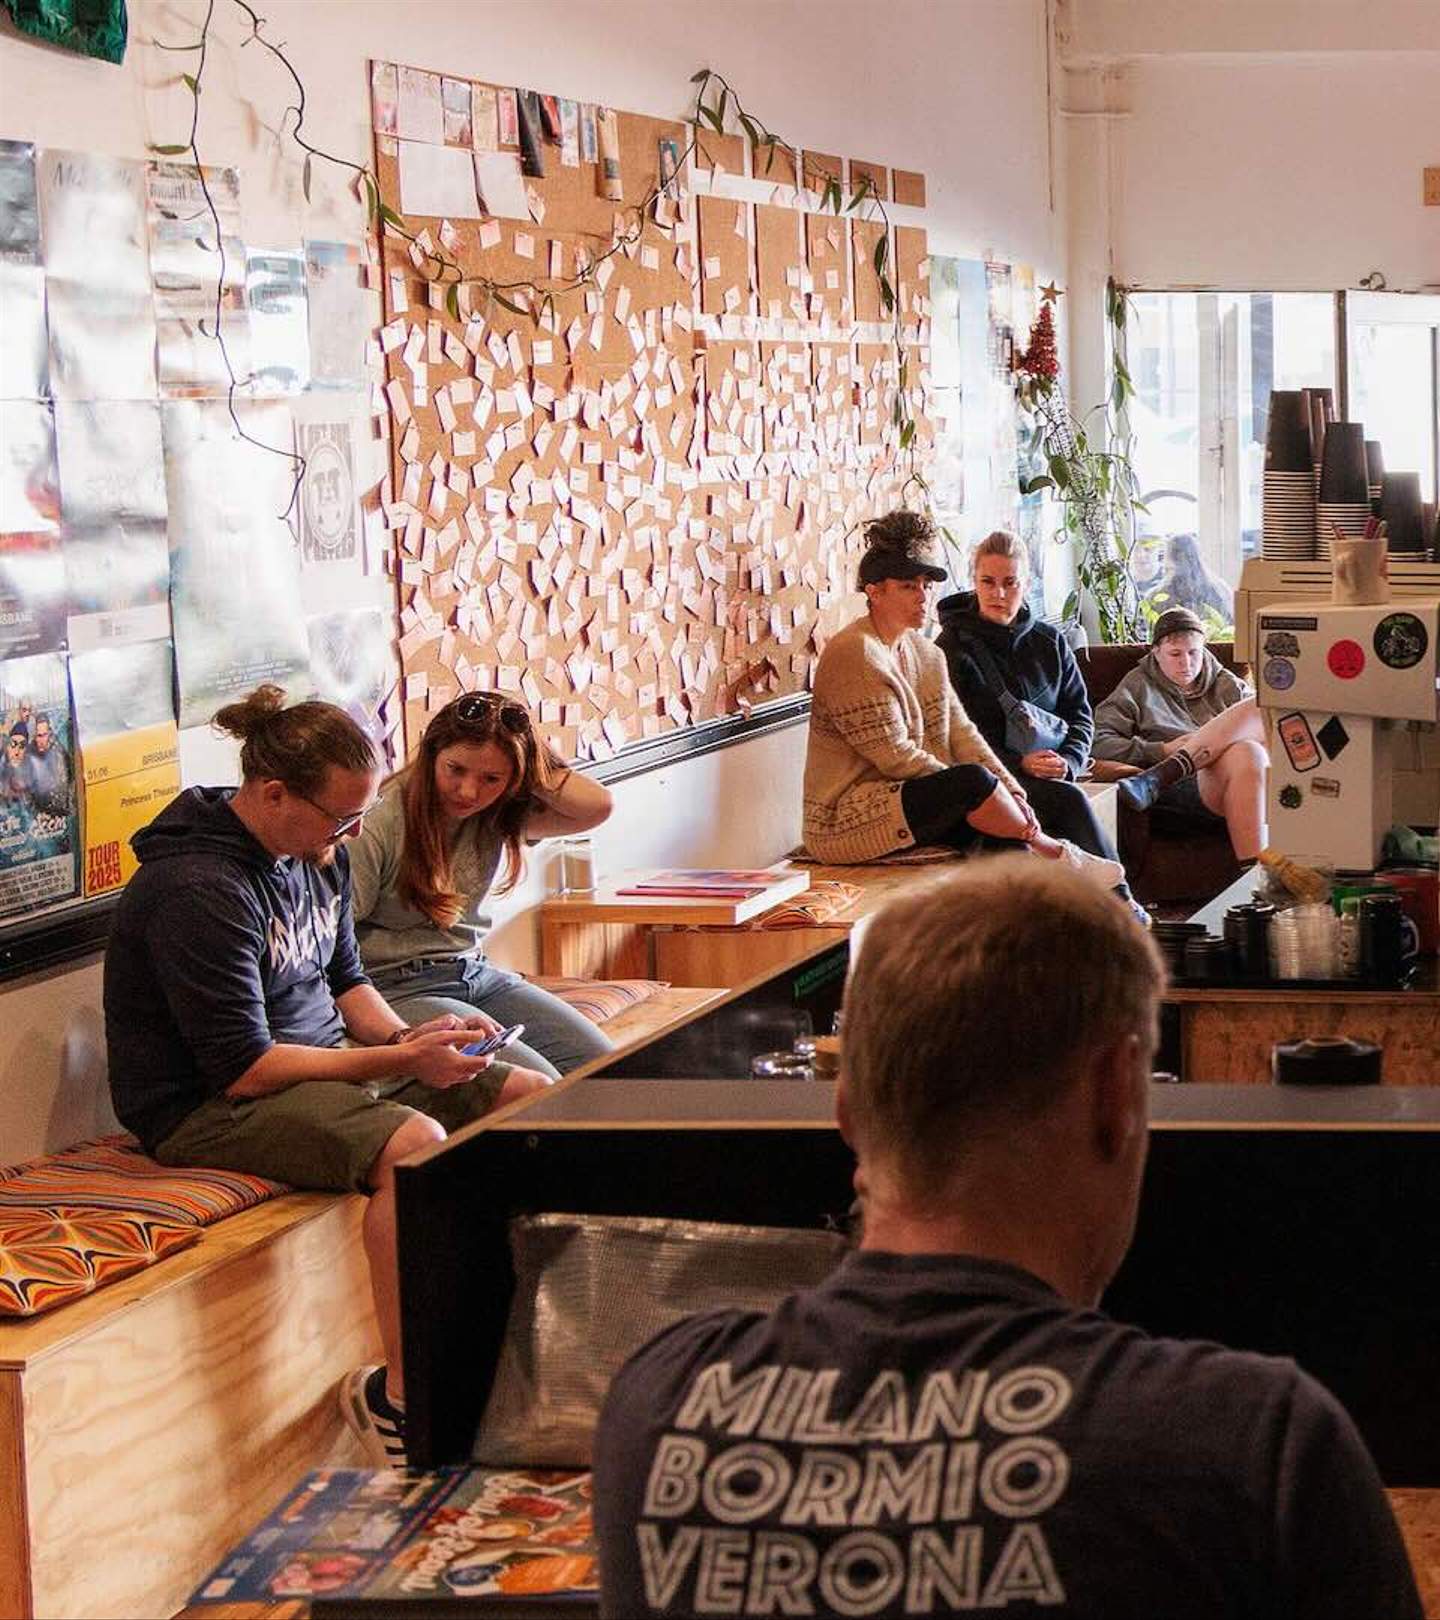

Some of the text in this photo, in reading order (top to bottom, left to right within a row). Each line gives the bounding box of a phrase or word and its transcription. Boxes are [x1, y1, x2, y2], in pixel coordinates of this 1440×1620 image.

[88, 841, 120, 869] TOUR
[88, 864, 122, 892] 2025
[673, 1361, 1073, 1444] MILANO
[643, 1434, 1071, 1526] BORMIO
[636, 1523, 1067, 1617] VERONA
